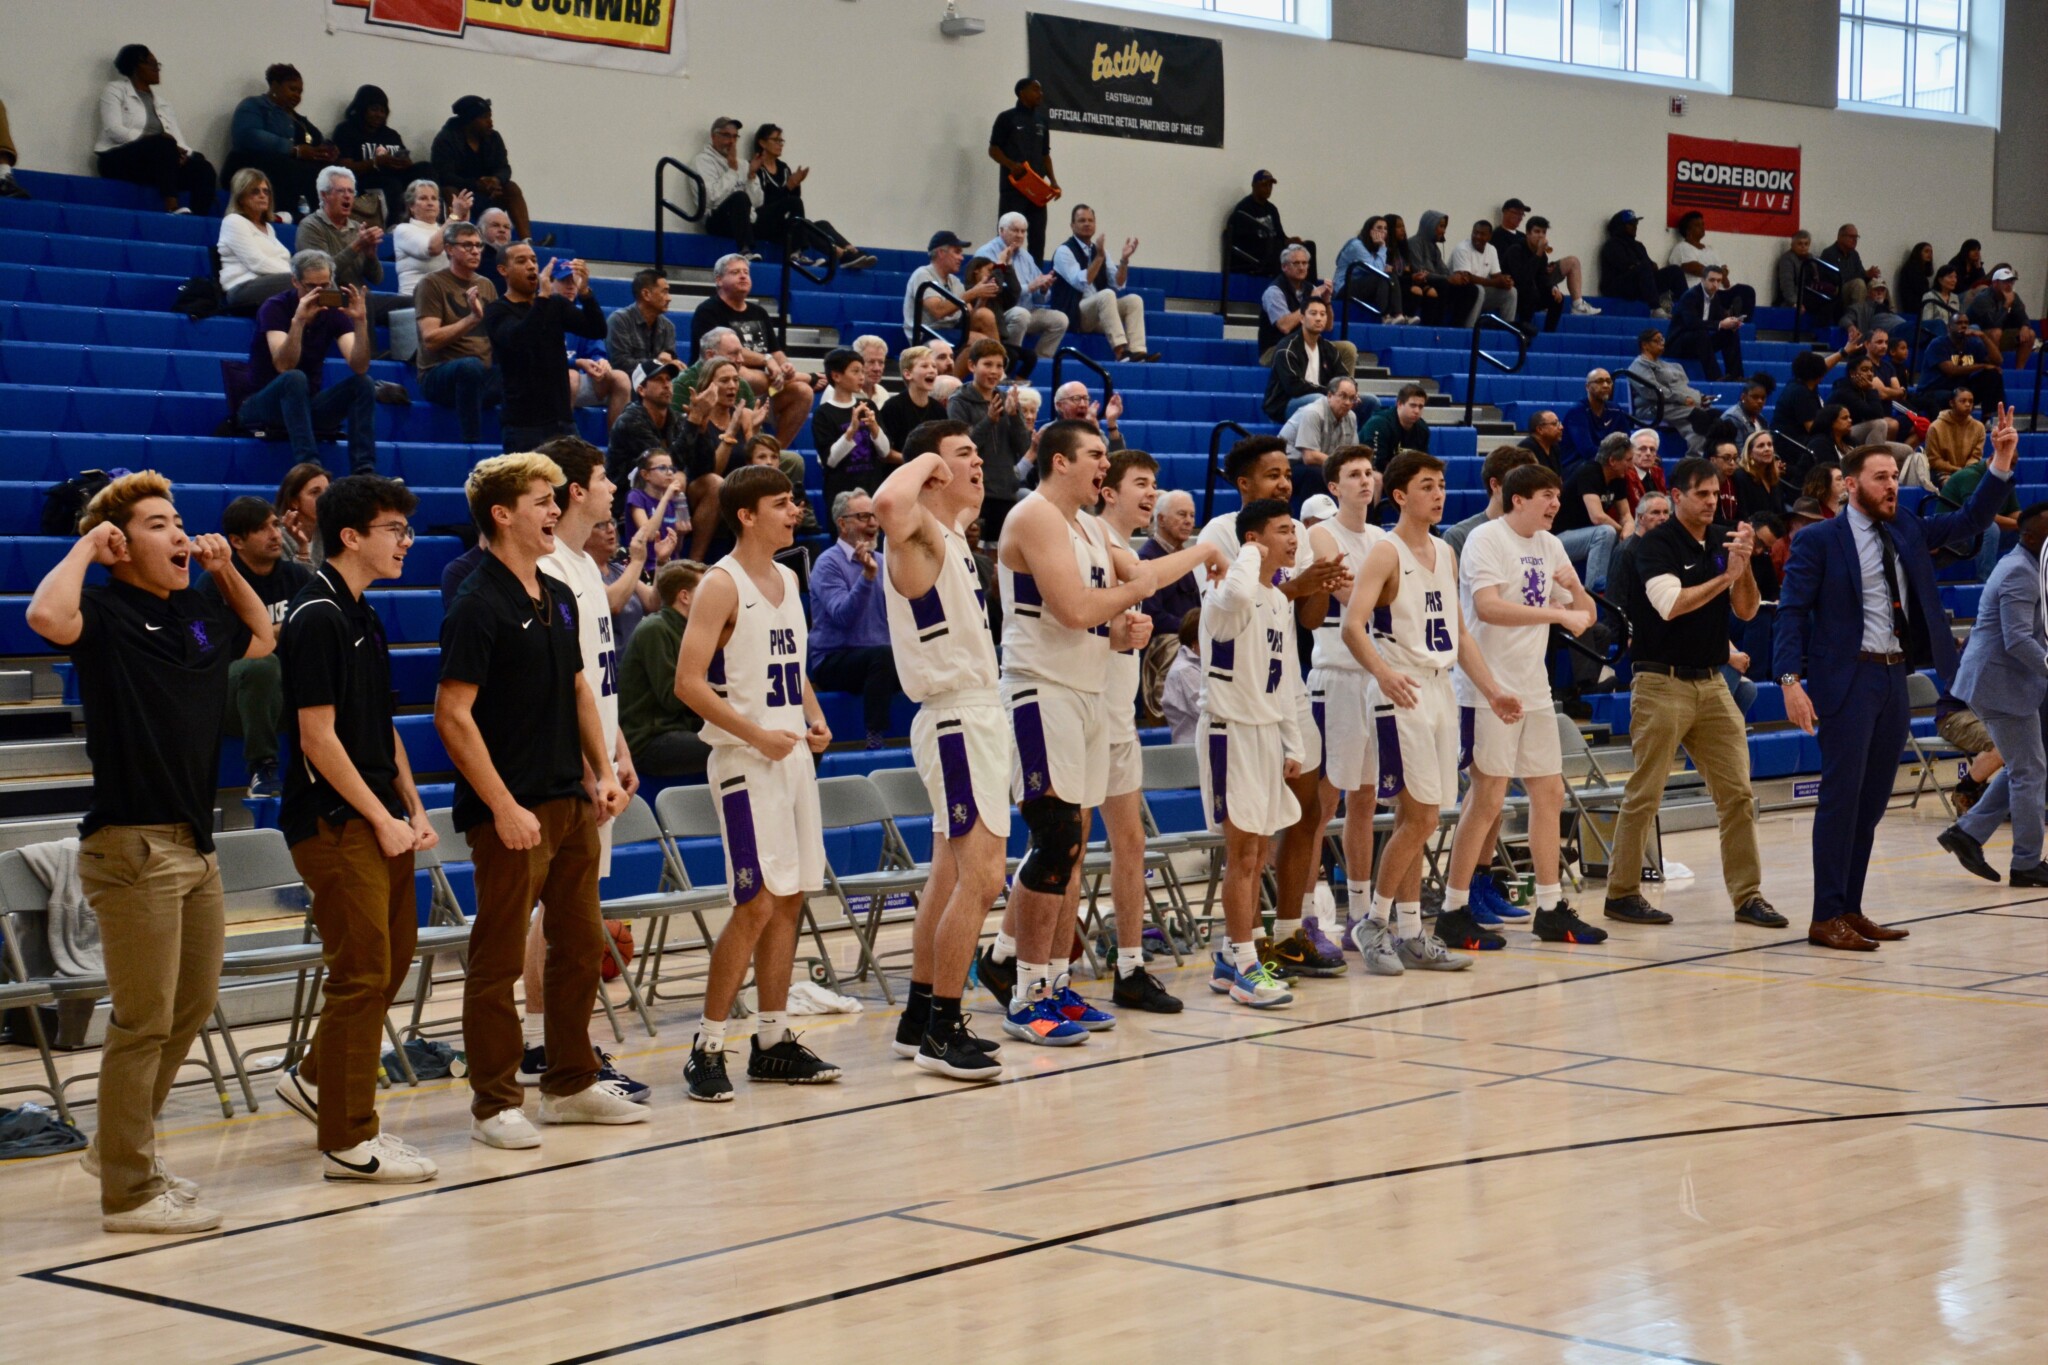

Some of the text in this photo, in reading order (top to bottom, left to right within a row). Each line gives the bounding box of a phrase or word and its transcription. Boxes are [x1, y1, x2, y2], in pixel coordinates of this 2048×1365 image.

[1091, 39, 1164, 85] Eastbay
[1105, 91, 1153, 106] EASTBAY.COM
[1048, 108, 1204, 136] OFFICIAL ATHLETIC RETAIL PARTNER OF THE CIF
[1677, 160, 1794, 191] SCOREBOOK
[1742, 191, 1790, 209] LIVE
[1425, 590, 1443, 613] PHS
[769, 628, 797, 656] PHS
[1425, 617, 1453, 652] 15
[598, 650, 618, 697] 20
[766, 661, 803, 707] 30
